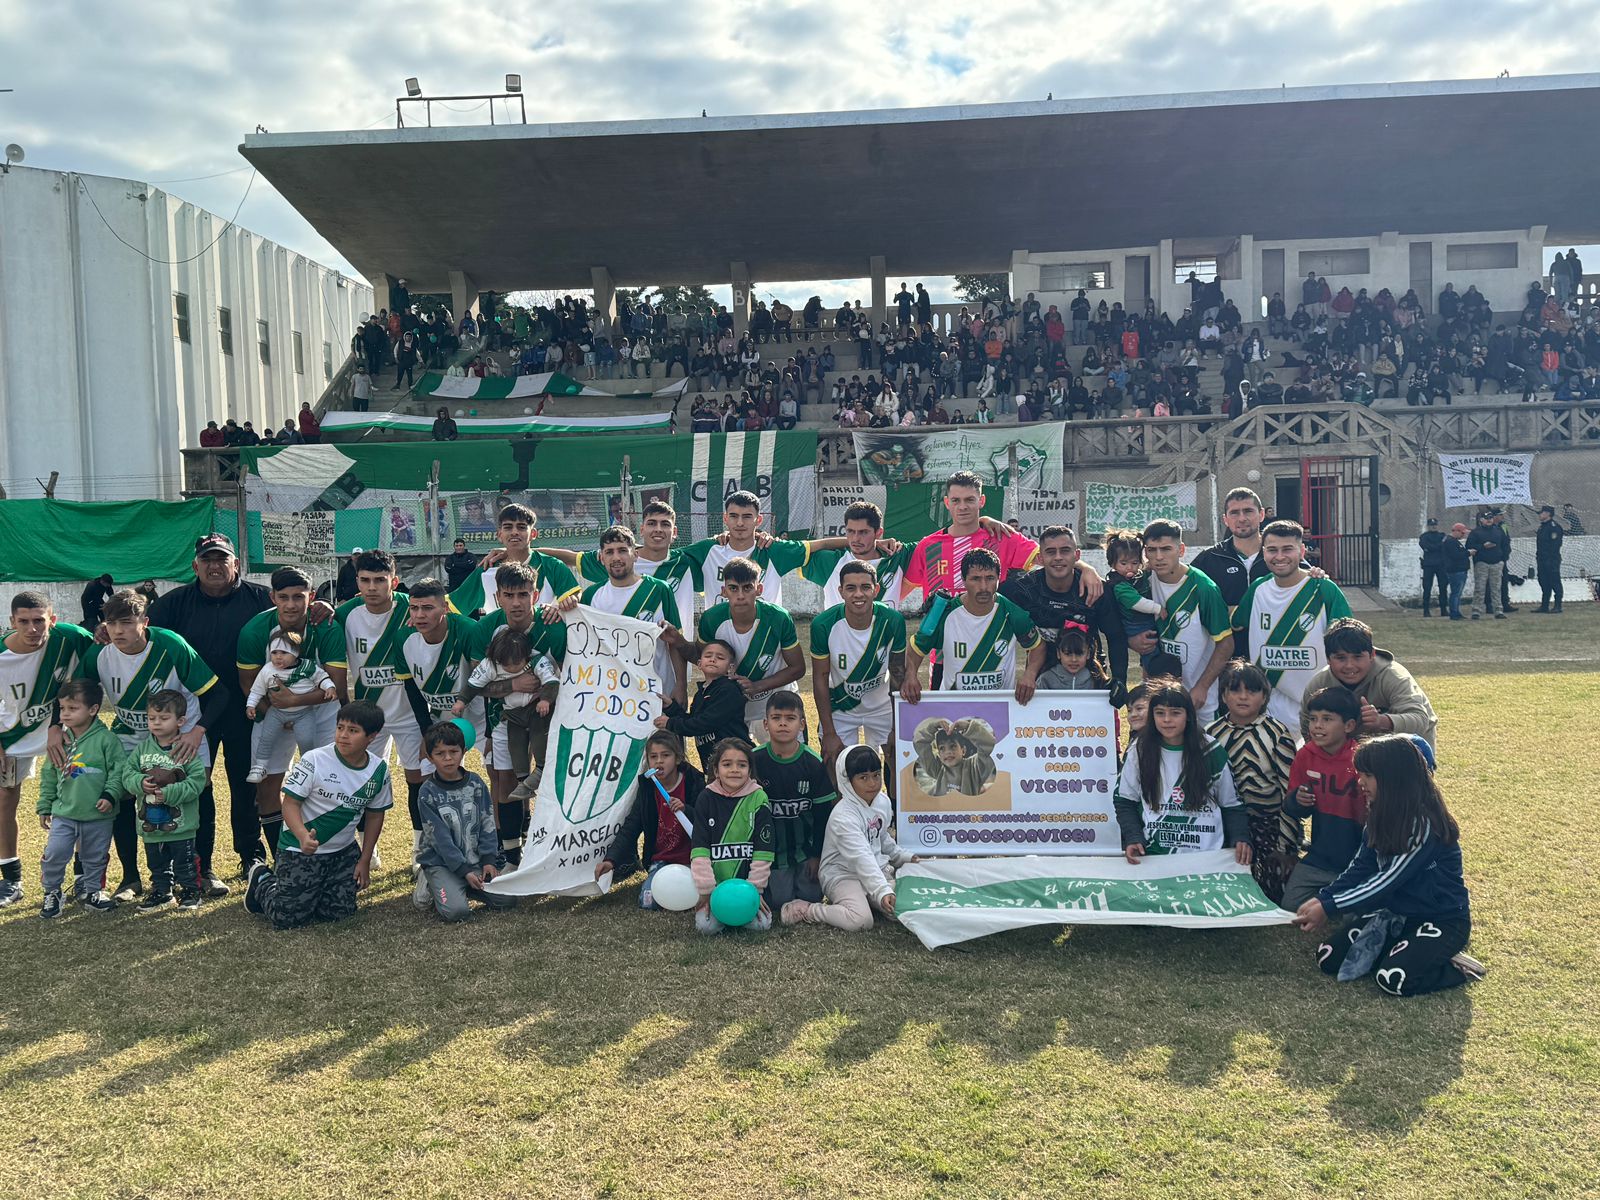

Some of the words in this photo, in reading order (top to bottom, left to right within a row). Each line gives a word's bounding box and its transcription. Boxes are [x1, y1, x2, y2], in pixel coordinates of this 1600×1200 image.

[735, 290, 745, 306] B
[1260, 613, 1271, 630] 13
[355, 638, 367, 654] 16
[953, 641, 967, 659] 10
[1265, 648, 1309, 660] UATRE
[838, 654, 847, 671] 8
[413, 664, 424, 681] 14
[962, 673, 1003, 685] UATRE
[10, 683, 26, 700] 17
[112, 677, 121, 694] 11
[638, 678, 656, 693] DE
[574, 691, 650, 722] TODOS
[1049, 709, 1072, 721] UN
[1015, 726, 1108, 738] INTESTINO
[1017, 746, 1027, 758] E
[1035, 743, 1108, 758] HÍGADO
[568, 752, 622, 782] CAB
[1045, 762, 1080, 773] PARA
[317, 788, 334, 799] Sur
[1020, 779, 1109, 794] VICENTE
[551, 822, 622, 850] MARCELO
[943, 828, 1096, 843] TODOSPORVICEN
[1160, 832, 1167, 841] EL
[1168, 833, 1201, 844] TALADRO
[711, 845, 753, 859] UATRE
[571, 854, 590, 866] 100
[1045, 884, 1059, 896] EL
[1202, 891, 1267, 918] ALMA
